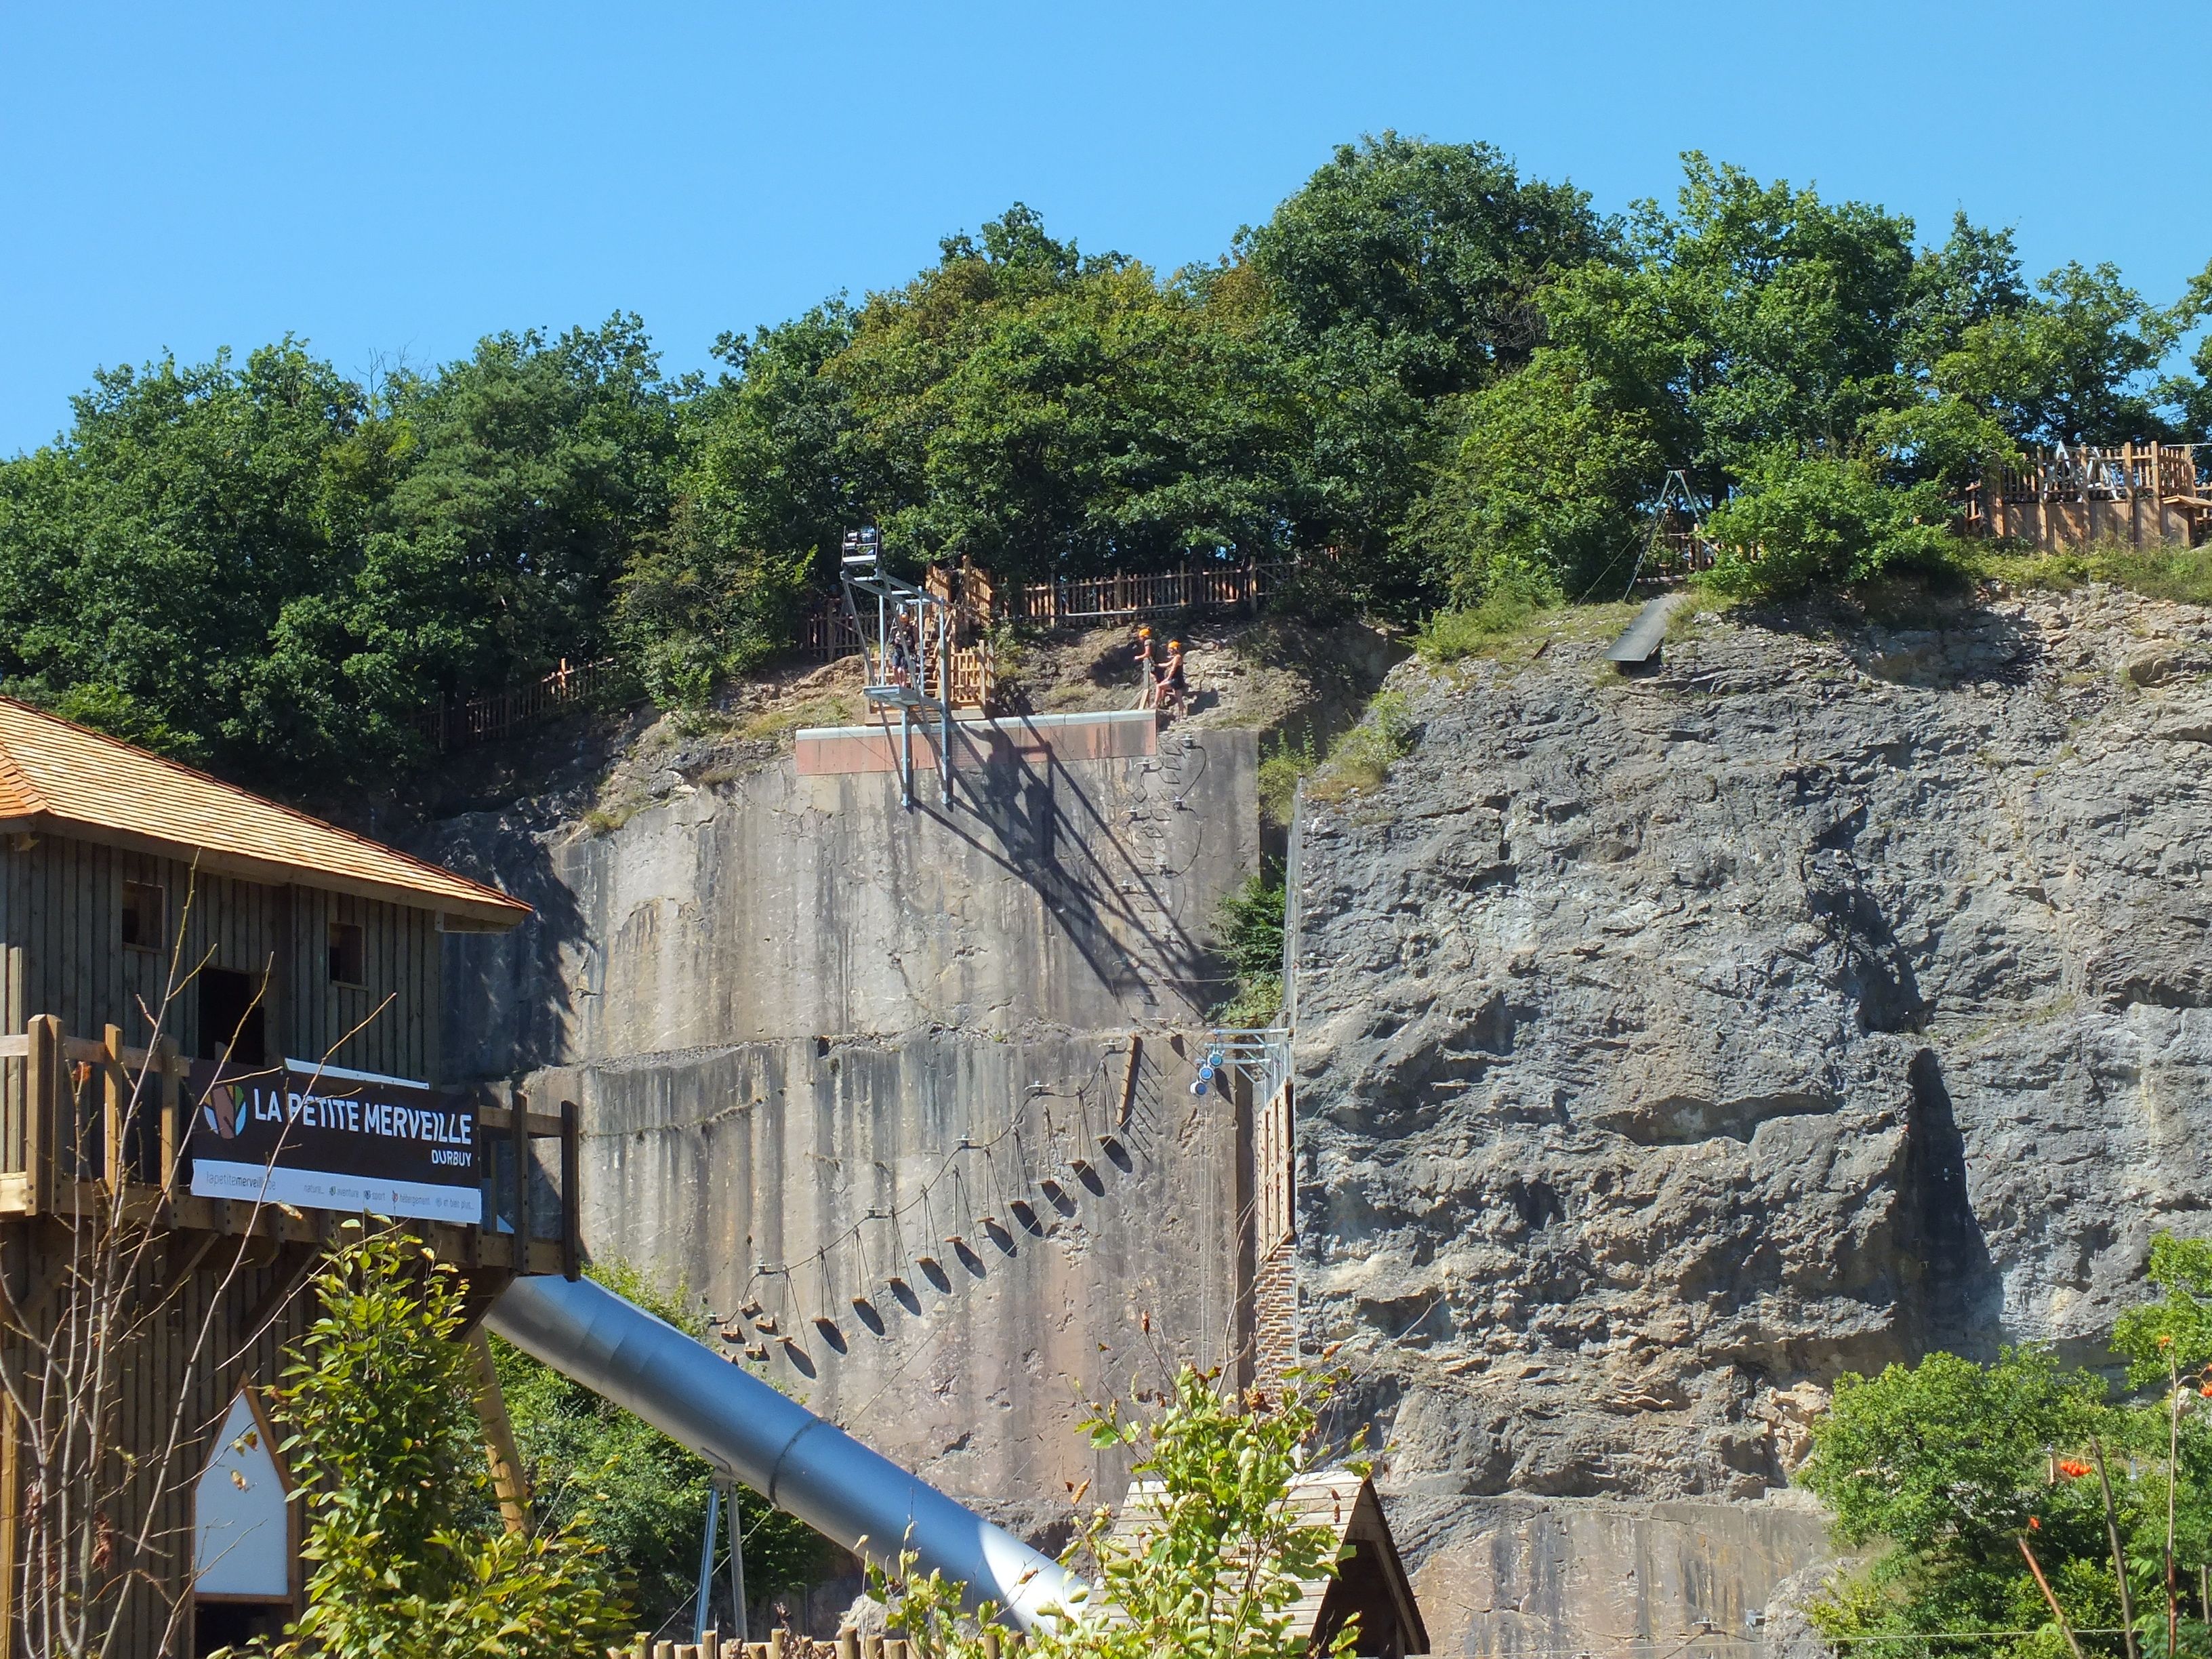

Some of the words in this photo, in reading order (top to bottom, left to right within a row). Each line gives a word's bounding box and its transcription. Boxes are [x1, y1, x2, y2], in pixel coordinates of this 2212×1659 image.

[253, 1088, 283, 1122] LA
[288, 1092, 359, 1132] PETITE
[365, 1103, 472, 1145] MERVEILLE
[432, 1149, 472, 1167] DURBUY
